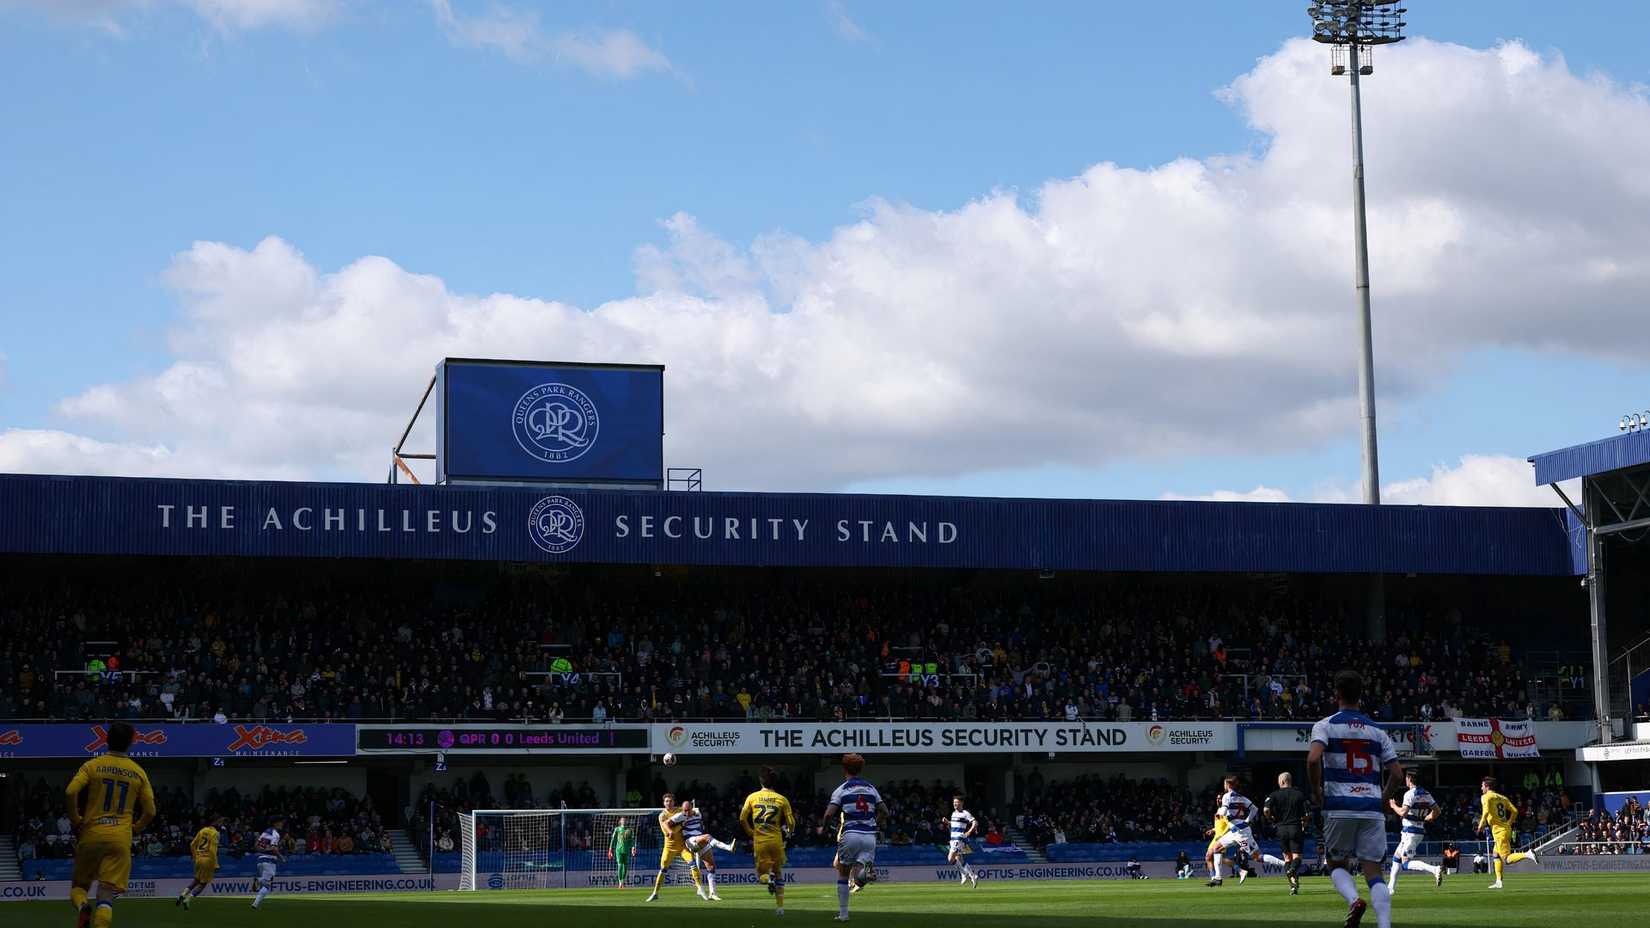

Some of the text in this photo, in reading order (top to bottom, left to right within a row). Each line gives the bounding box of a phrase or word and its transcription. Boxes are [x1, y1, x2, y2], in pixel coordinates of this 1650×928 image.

[516, 386, 596, 426] QUEENS PARK RANGERS
[157, 505, 497, 534] THE ACHILLEUS
[615, 515, 958, 544] SECURITY STAND
[386, 731, 601, 745] 14:13 QPR 0 0 Leeds United
[691, 731, 741, 740] ACHILLEUS
[692, 739, 737, 748] SECURITY
[759, 728, 1127, 748] THE ACHILLEUS SECURITY STAND
[1168, 730, 1214, 739] ACHILLEUS
[1170, 738, 1210, 746] SECURITY
[1505, 737, 1535, 746] UNITED
[101, 778, 130, 815] 11
[856, 793, 870, 815] 4
[754, 803, 781, 824] 22
[1496, 802, 1507, 818] 8
